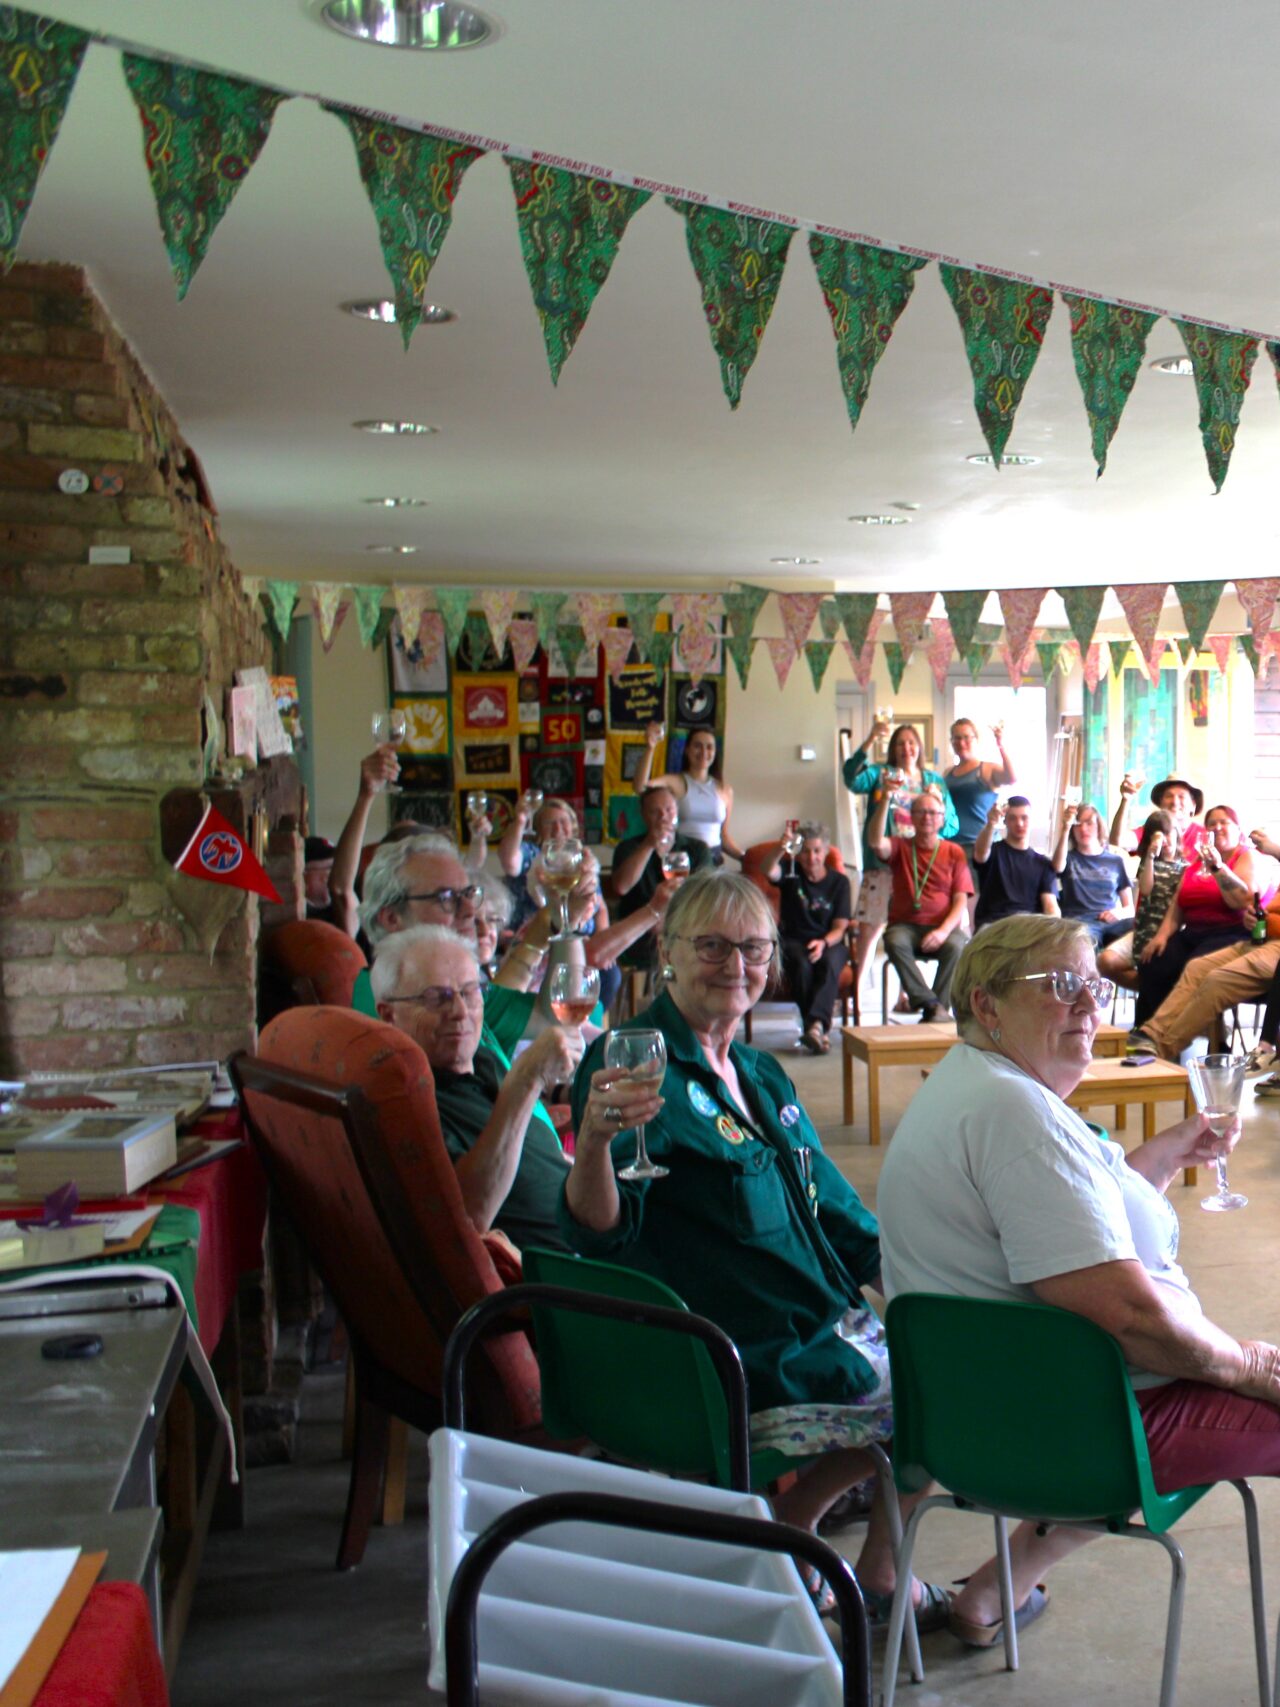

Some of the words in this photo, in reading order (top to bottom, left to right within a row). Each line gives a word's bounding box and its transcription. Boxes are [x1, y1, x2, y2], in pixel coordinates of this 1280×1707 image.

[422, 122, 485, 145] WOODCRAFT
[484, 137, 511, 153] FOLK
[532, 150, 588, 173] WOODCRAFT
[589, 163, 614, 179] FOLK
[633, 176, 686, 198] WOODCRAFT
[687, 188, 709, 203] FOLK
[727, 201, 776, 220] WOODCRAFT
[548, 718, 577, 741] 50
